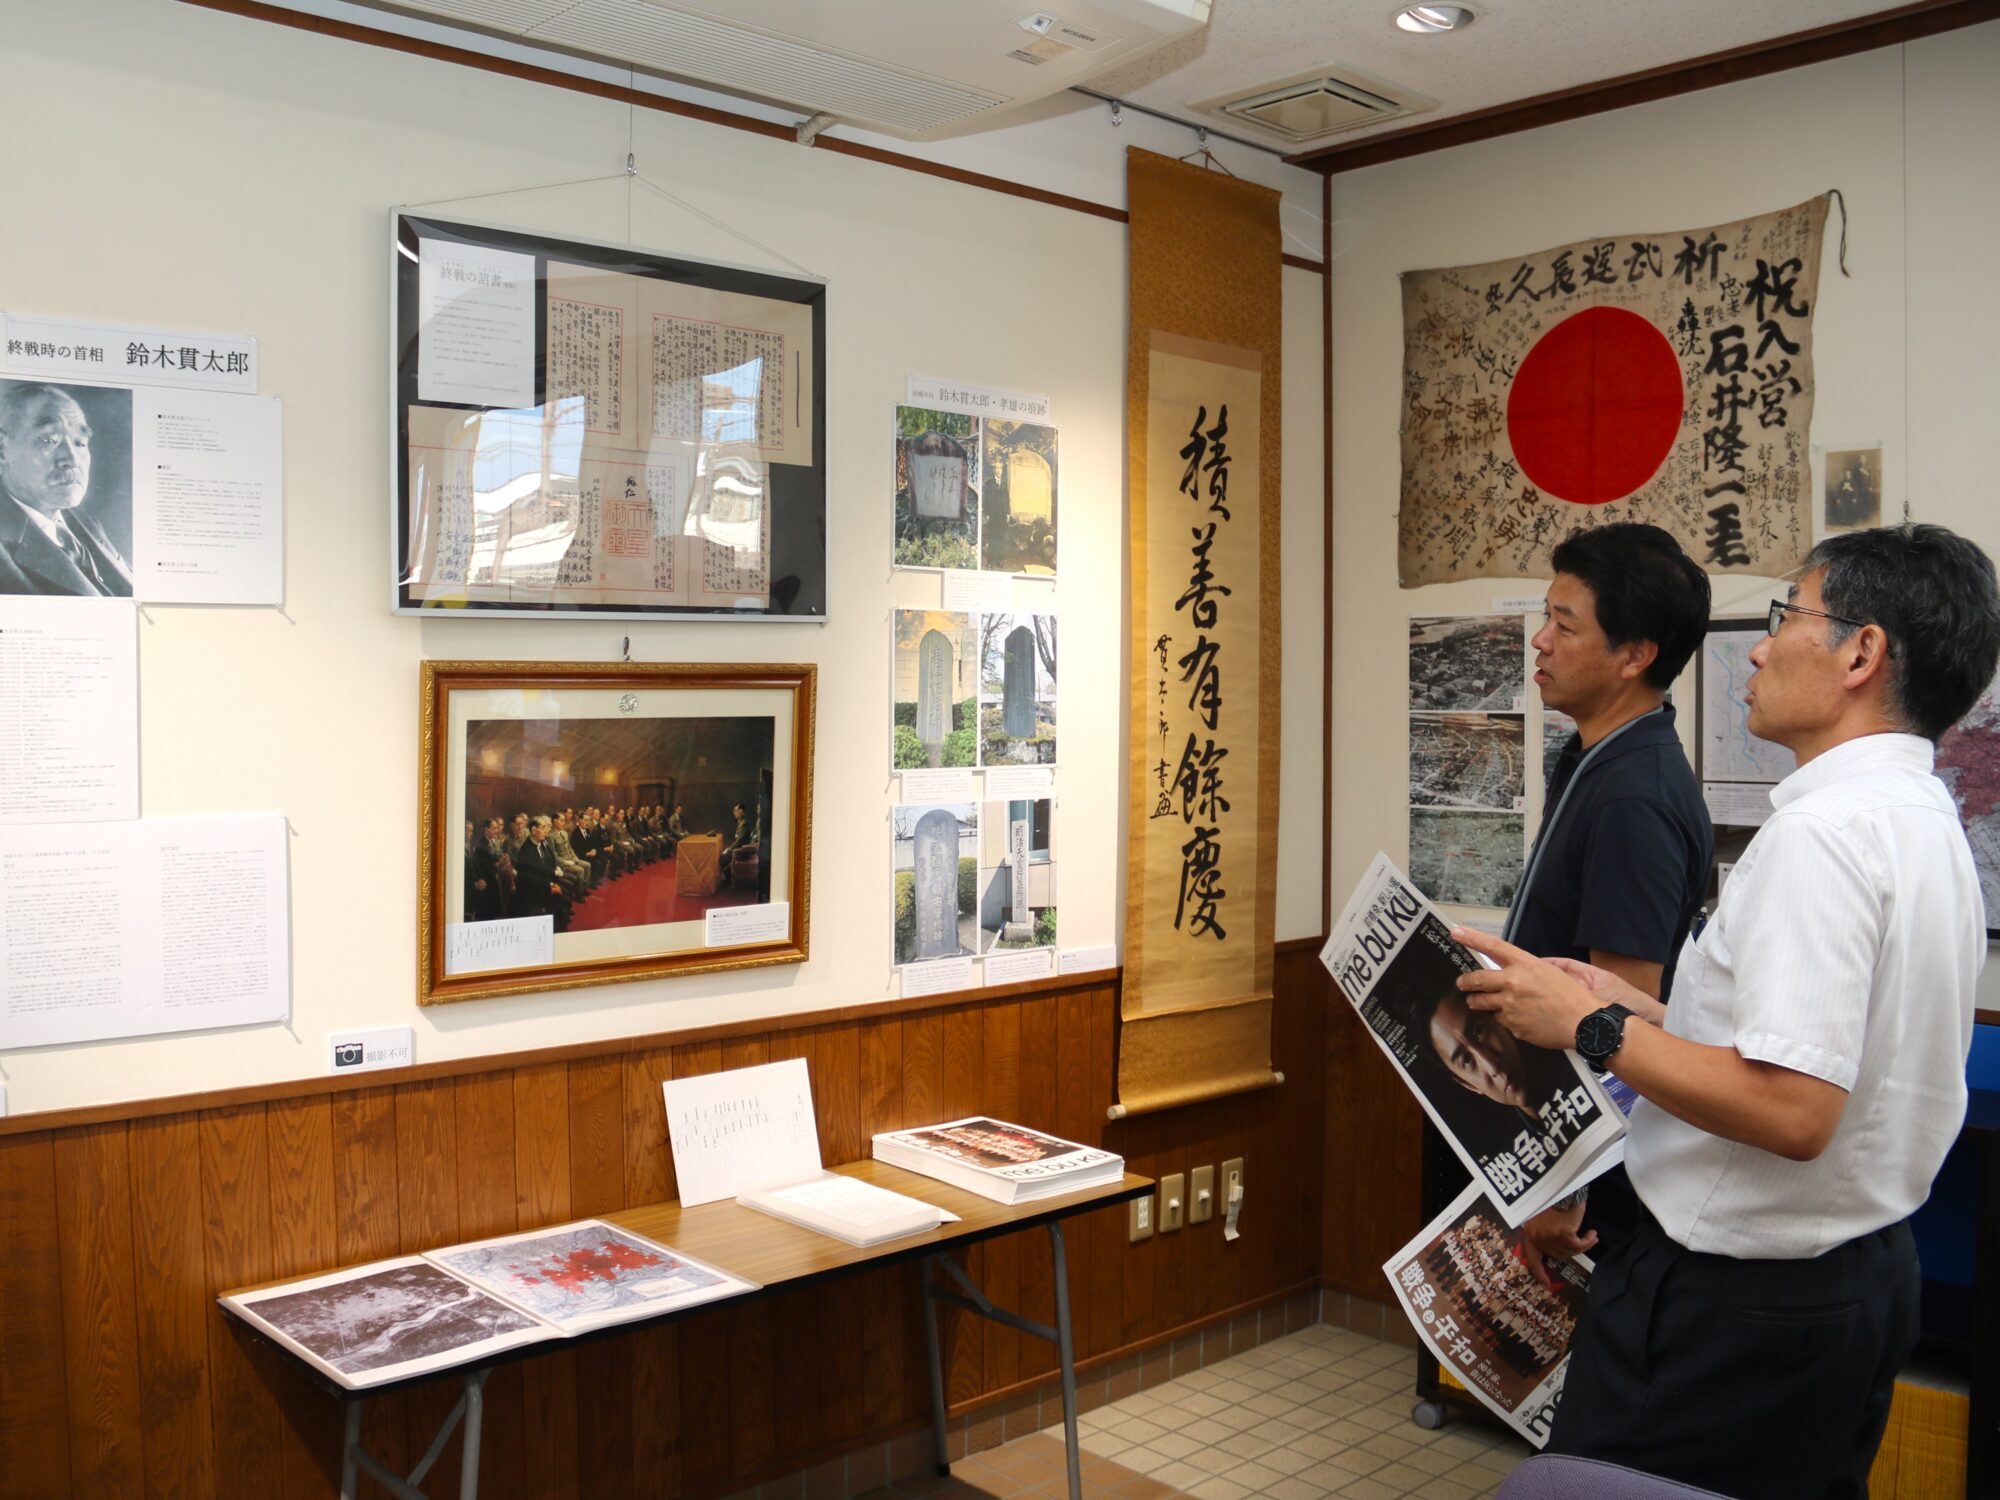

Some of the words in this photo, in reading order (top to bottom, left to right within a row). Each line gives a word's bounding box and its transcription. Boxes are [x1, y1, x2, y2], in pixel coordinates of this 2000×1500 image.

[7, 339, 104, 362] 終戦時の首相
[126, 341, 249, 376] 鈴木貫太郎
[1355, 920, 1398, 966] bu
[1341, 954, 1372, 1002] me
[366, 1047, 408, 1063] 撮影不可
[1484, 1085, 1595, 1197] 戦争と平和
[1400, 1259, 1477, 1366] 戦争と平和
